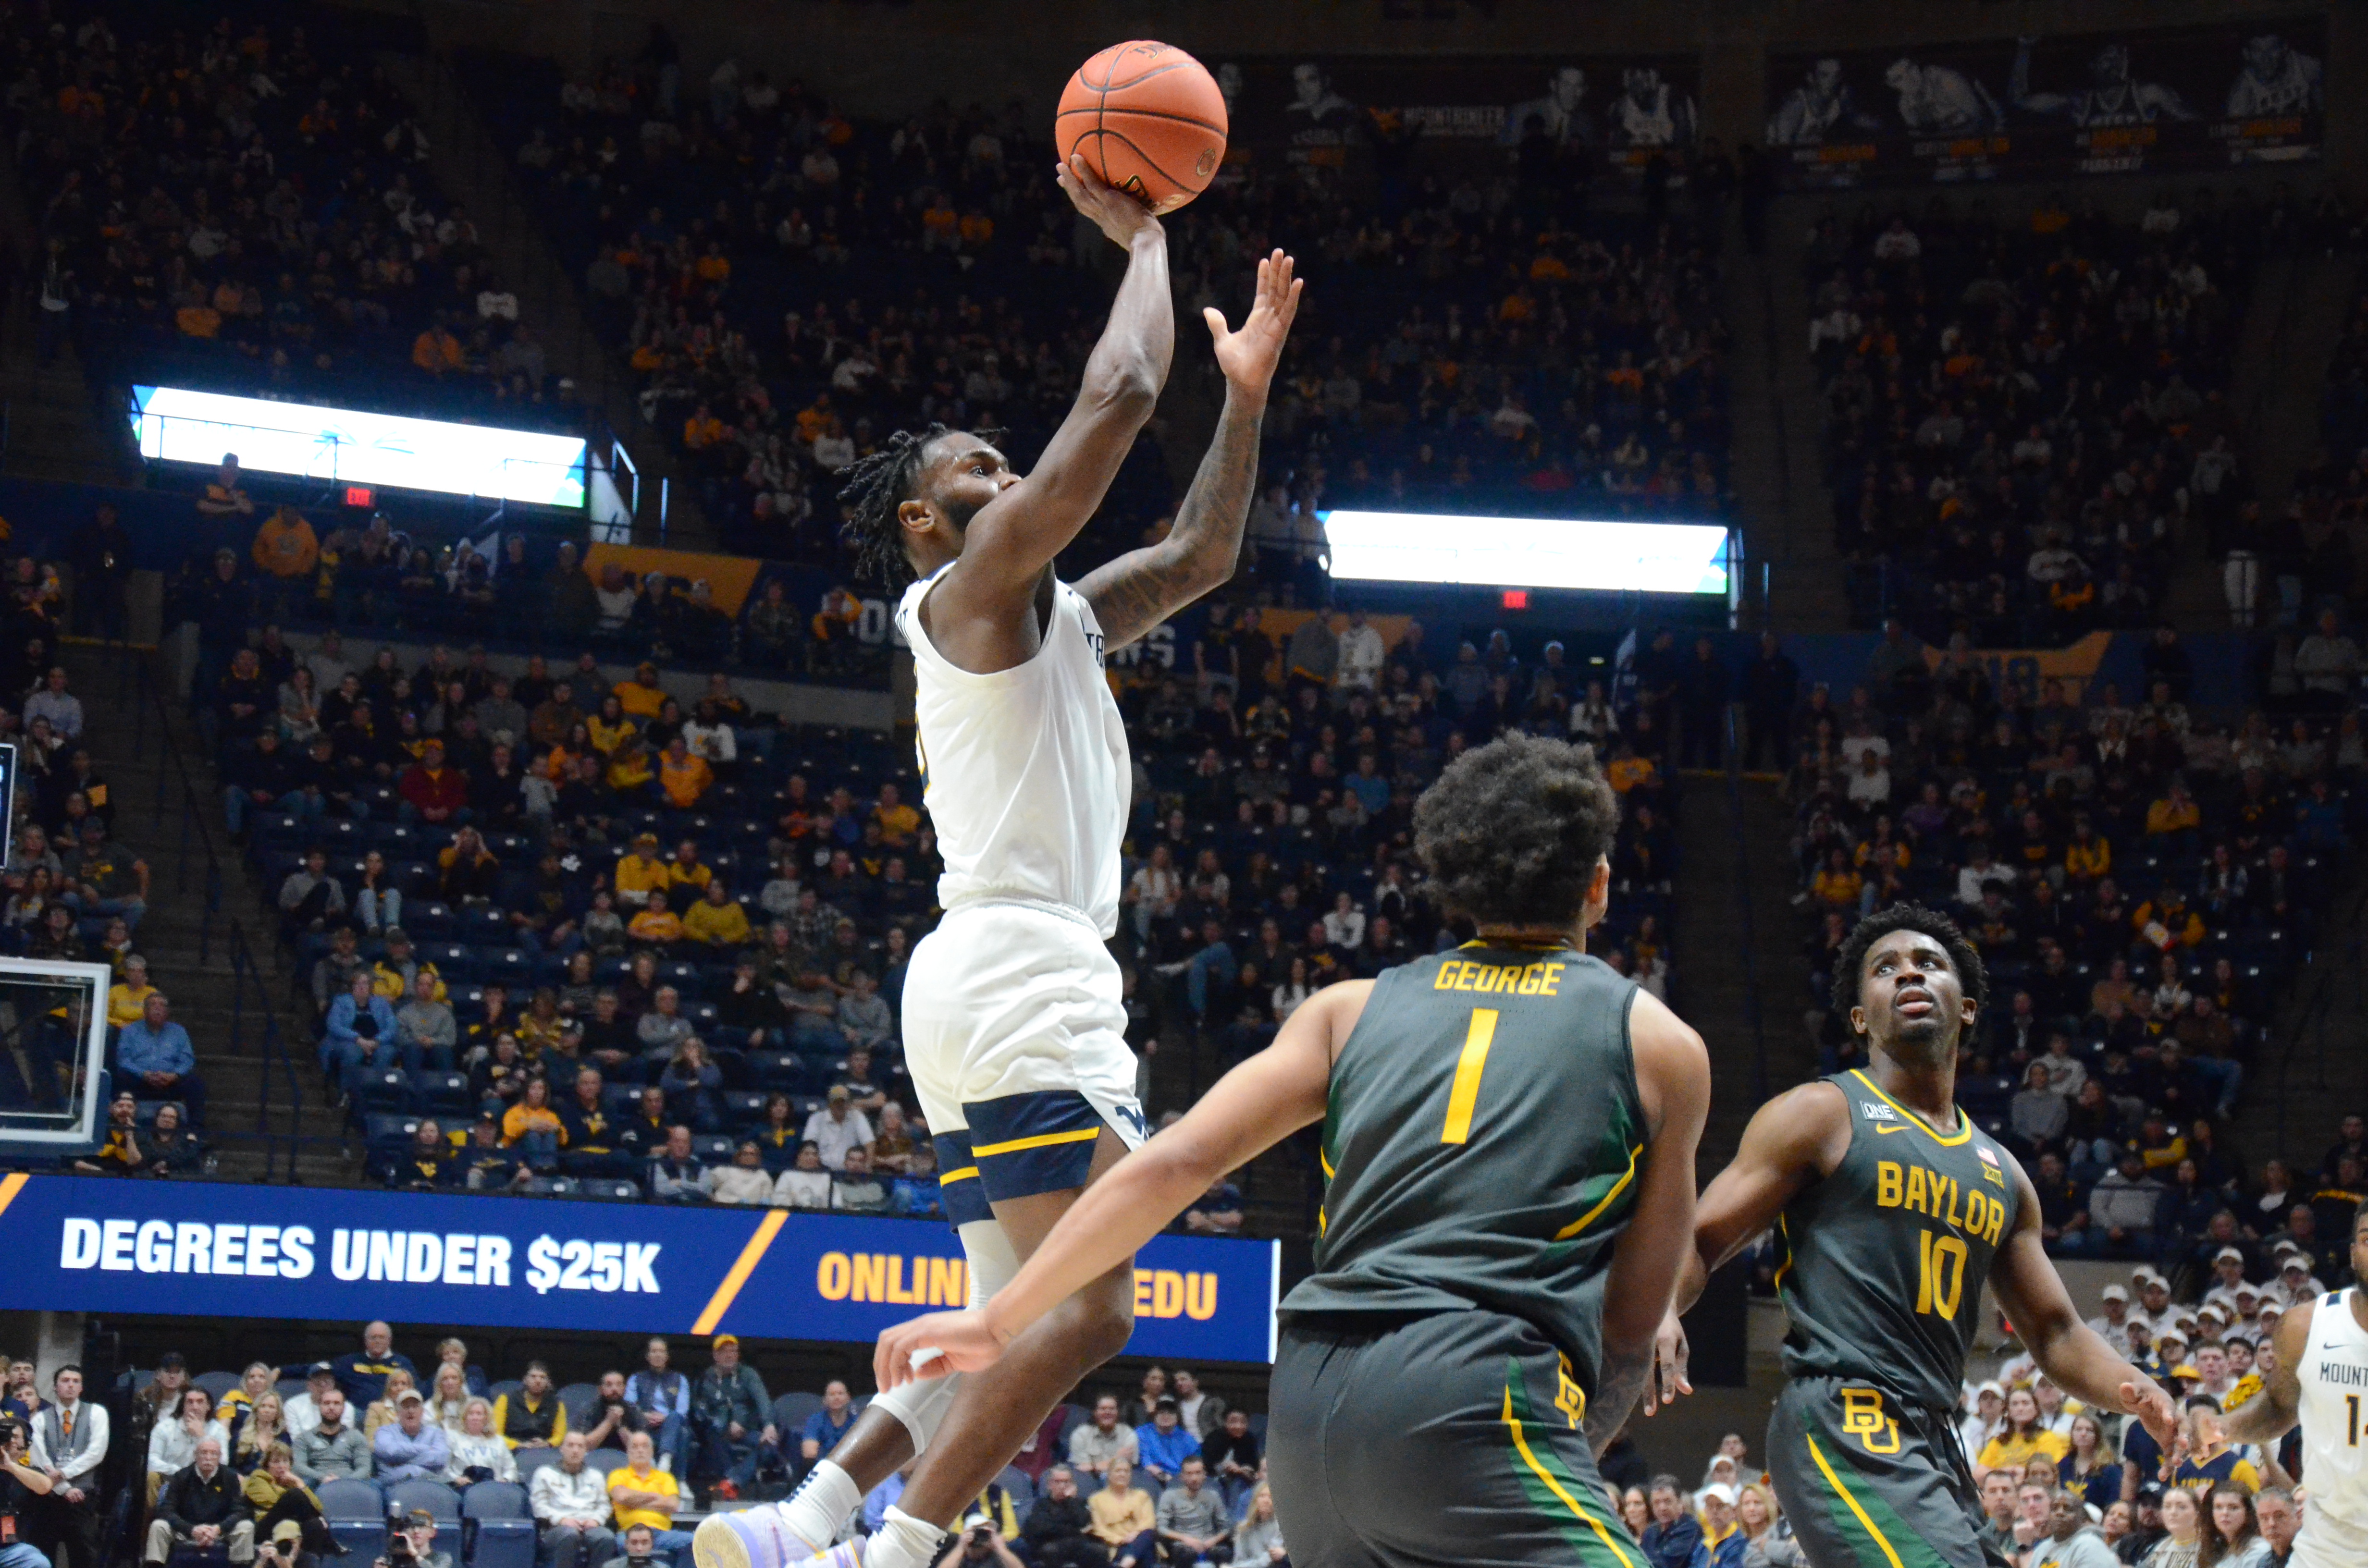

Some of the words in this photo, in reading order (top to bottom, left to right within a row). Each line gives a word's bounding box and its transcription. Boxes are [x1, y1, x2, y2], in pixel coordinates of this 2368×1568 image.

[1434, 960, 1566, 996] GEORGE
[1441, 1008, 1499, 1144] 1
[1878, 1161, 2004, 1247] BAYLOR
[61, 1218, 314, 1279] DEGREES
[332, 1228, 512, 1286] UNDER
[527, 1235, 661, 1295] $25K
[1916, 1230, 1968, 1321] 10
[1841, 1388, 1901, 1454] BU
